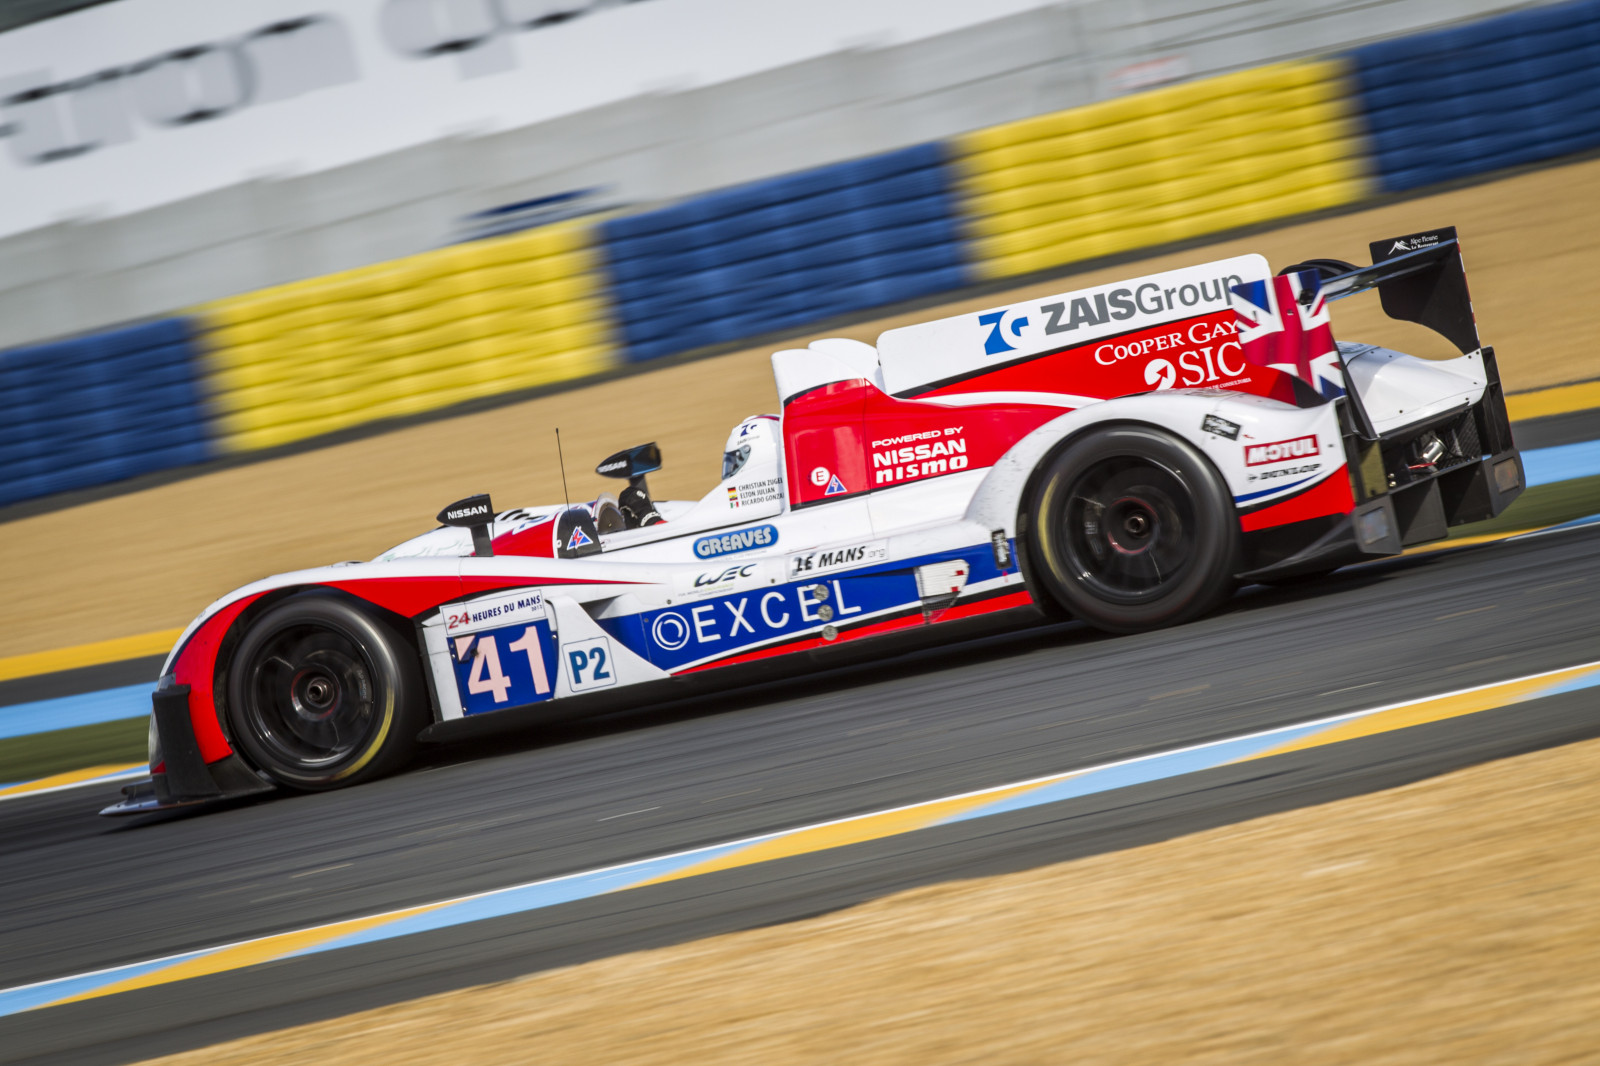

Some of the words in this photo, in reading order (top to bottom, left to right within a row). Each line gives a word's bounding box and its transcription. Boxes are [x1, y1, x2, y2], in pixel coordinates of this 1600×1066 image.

[1040, 274, 1243, 336] ZAISGroup
[1094, 332, 1185, 366] COOPER
[1187, 319, 1241, 345] GAY
[1178, 341, 1247, 386] SIC
[872, 430, 941, 448] POWERED
[944, 426, 964, 436] BY
[1247, 437, 1318, 464] MOTUL
[872, 438, 967, 468] NISSAN
[875, 455, 969, 484] nismo
[1260, 463, 1321, 480] DUNLOP
[739, 482, 766, 491] CHRISTIAN
[740, 490, 756, 499] ELTON
[757, 487, 775, 496] JULIAN
[447, 504, 488, 520] NISSAN
[741, 497, 764, 506] RICARDO
[697, 526, 773, 557] GREAVES
[818, 546, 866, 568] MANS
[694, 563, 757, 587] WEC
[448, 612, 471, 629] 24
[472, 606, 502, 623] HEURES
[503, 602, 515, 613] DU
[517, 595, 541, 609] MANS
[691, 580, 862, 643] EXCEL
[467, 625, 550, 703] 41
[568, 646, 611, 684] P2
